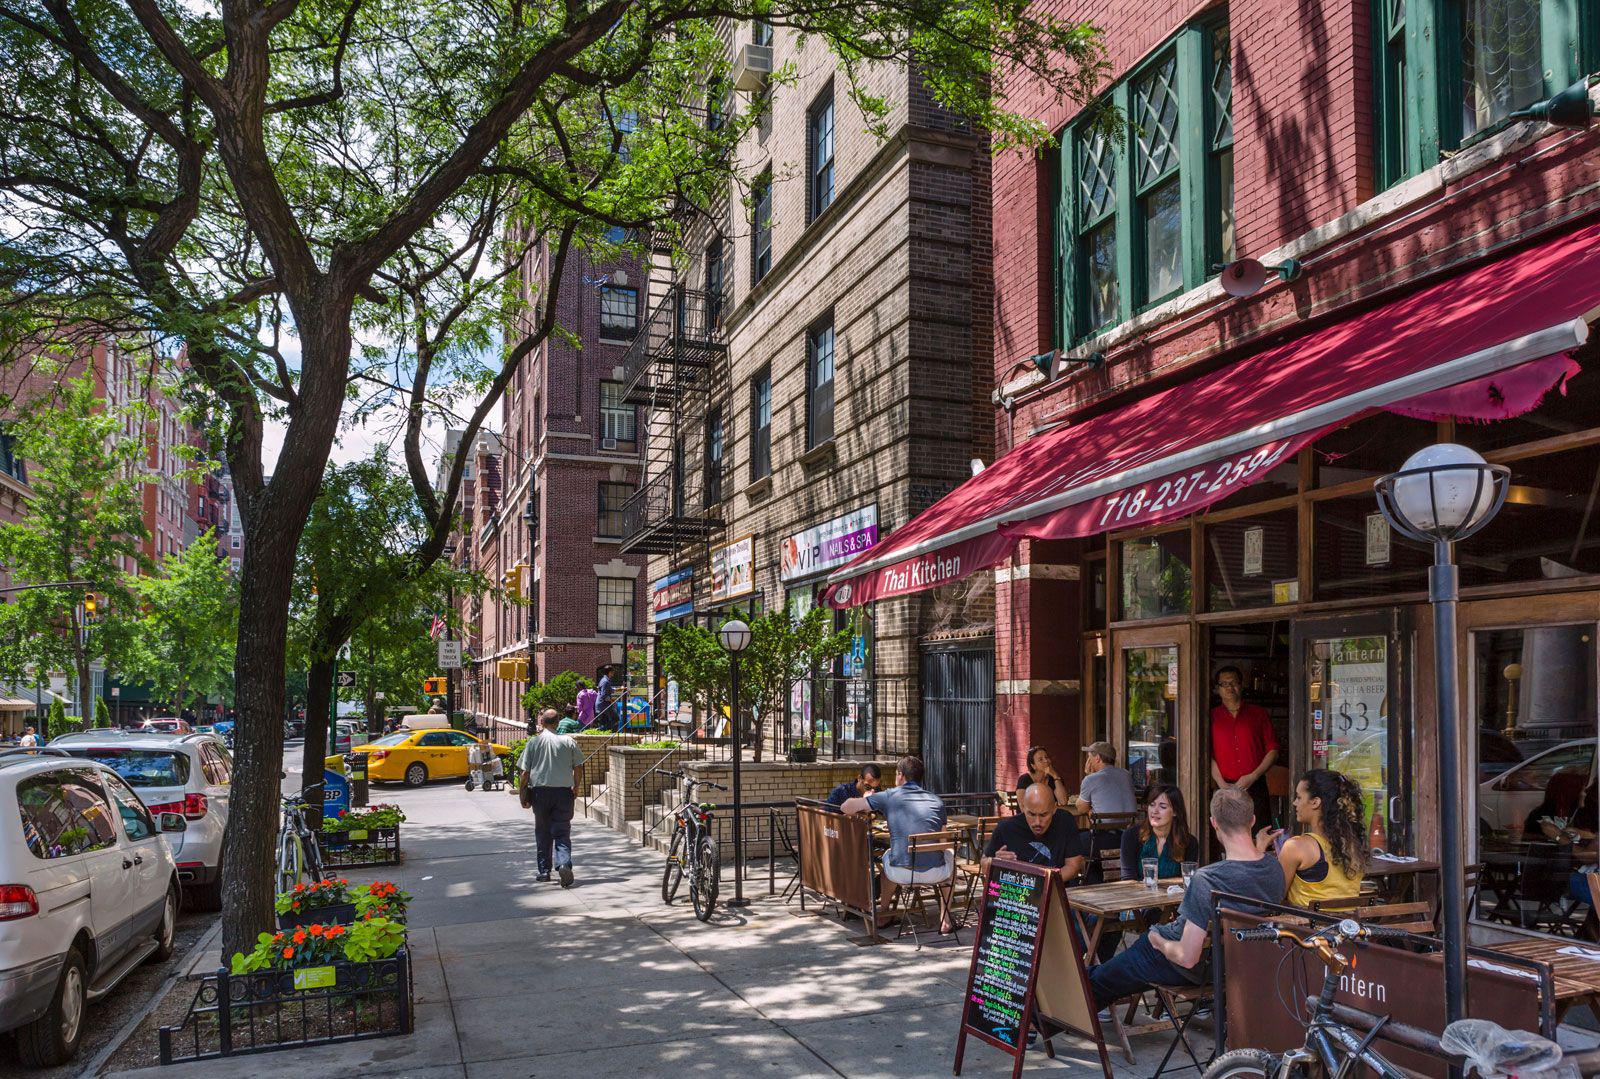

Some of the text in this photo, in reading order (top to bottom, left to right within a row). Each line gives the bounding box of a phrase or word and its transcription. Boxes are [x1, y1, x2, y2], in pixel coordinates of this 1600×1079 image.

[1100, 441, 1290, 525] 718-237-2594
[830, 540, 849, 556] NAILS
[850, 537, 855, 551] &
[856, 532, 872, 549] SPA
[883, 555, 960, 592] Thai Kitchen
[1366, 685, 1385, 693] BEER
[1339, 699, 1369, 735] $3
[1324, 965, 1386, 1003] lntern
